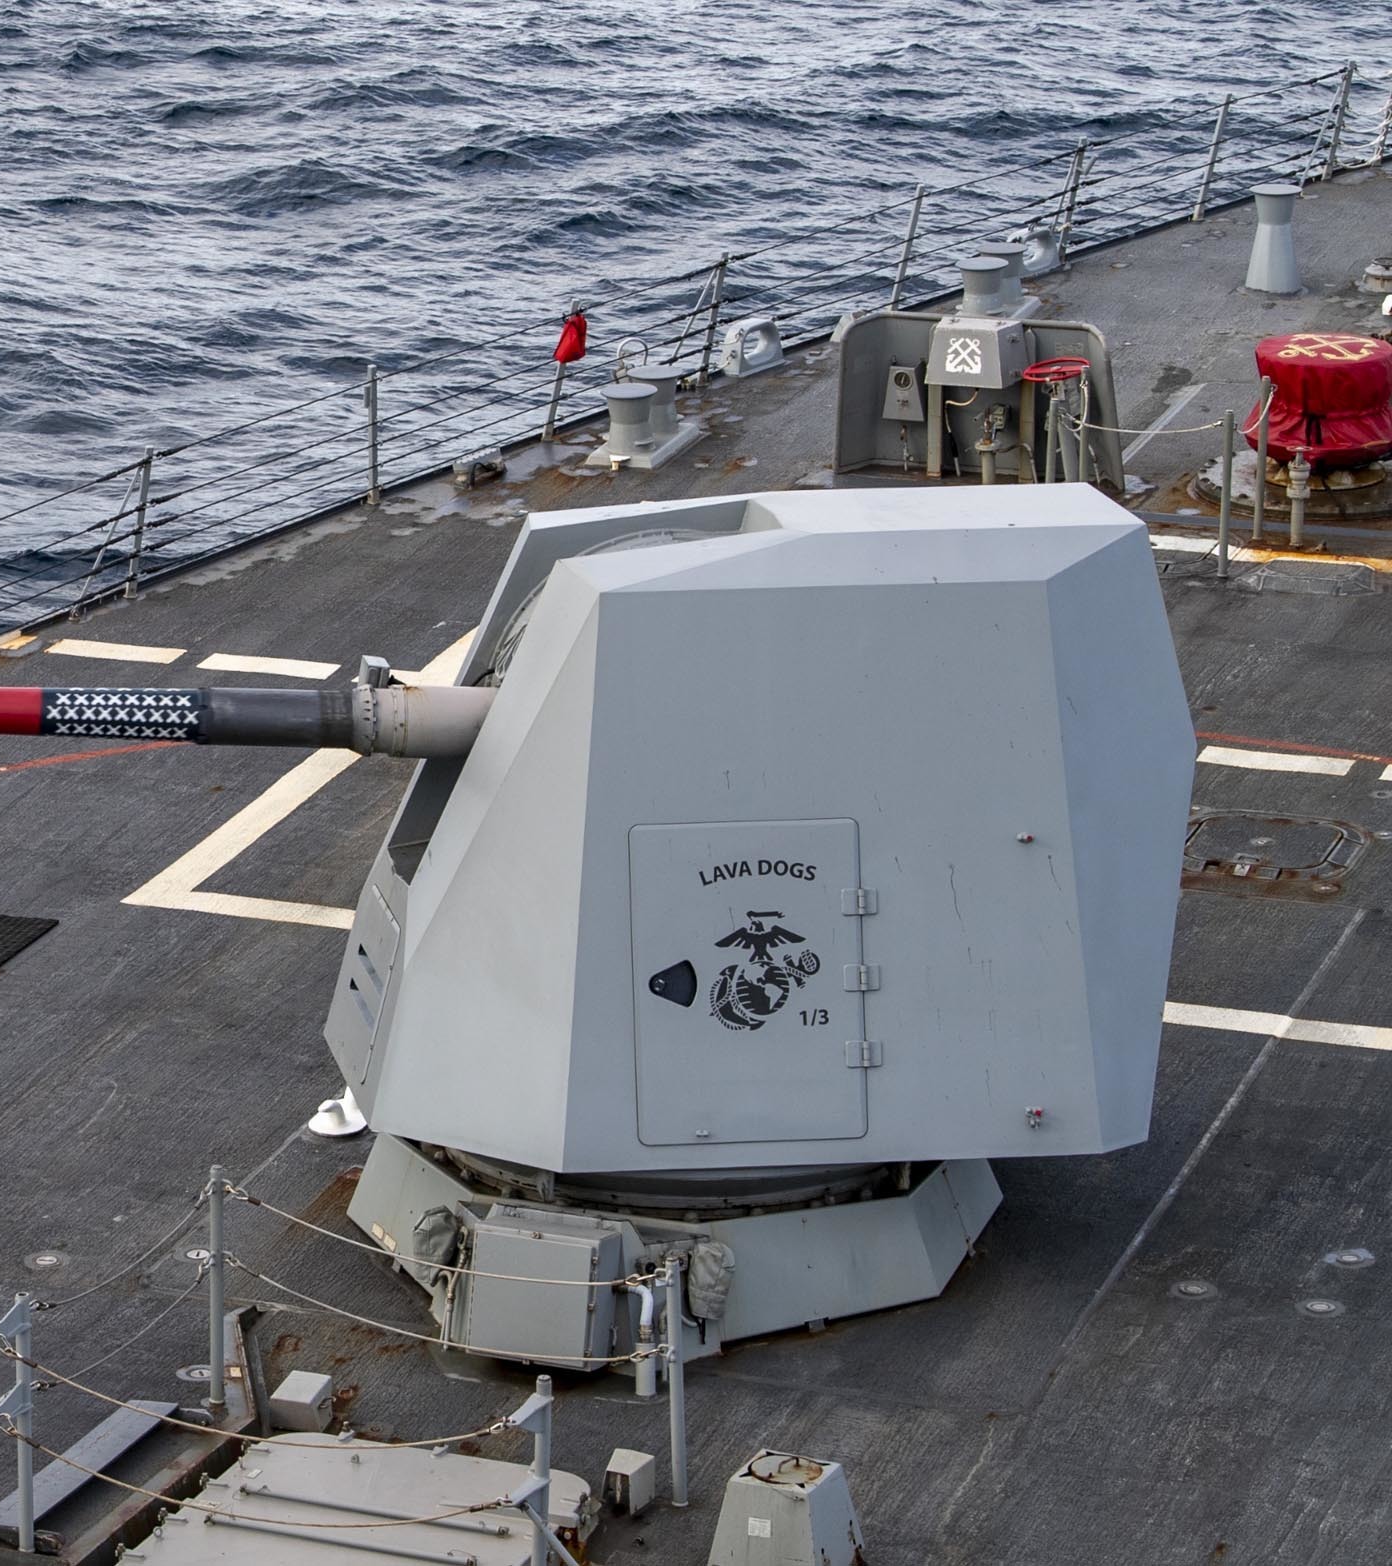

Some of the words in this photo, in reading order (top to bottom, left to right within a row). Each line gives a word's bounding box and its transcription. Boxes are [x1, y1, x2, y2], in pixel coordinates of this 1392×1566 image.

[698, 860, 753, 886] LAVA
[757, 859, 817, 881] DOGS
[799, 1008, 830, 1026] 1/3
